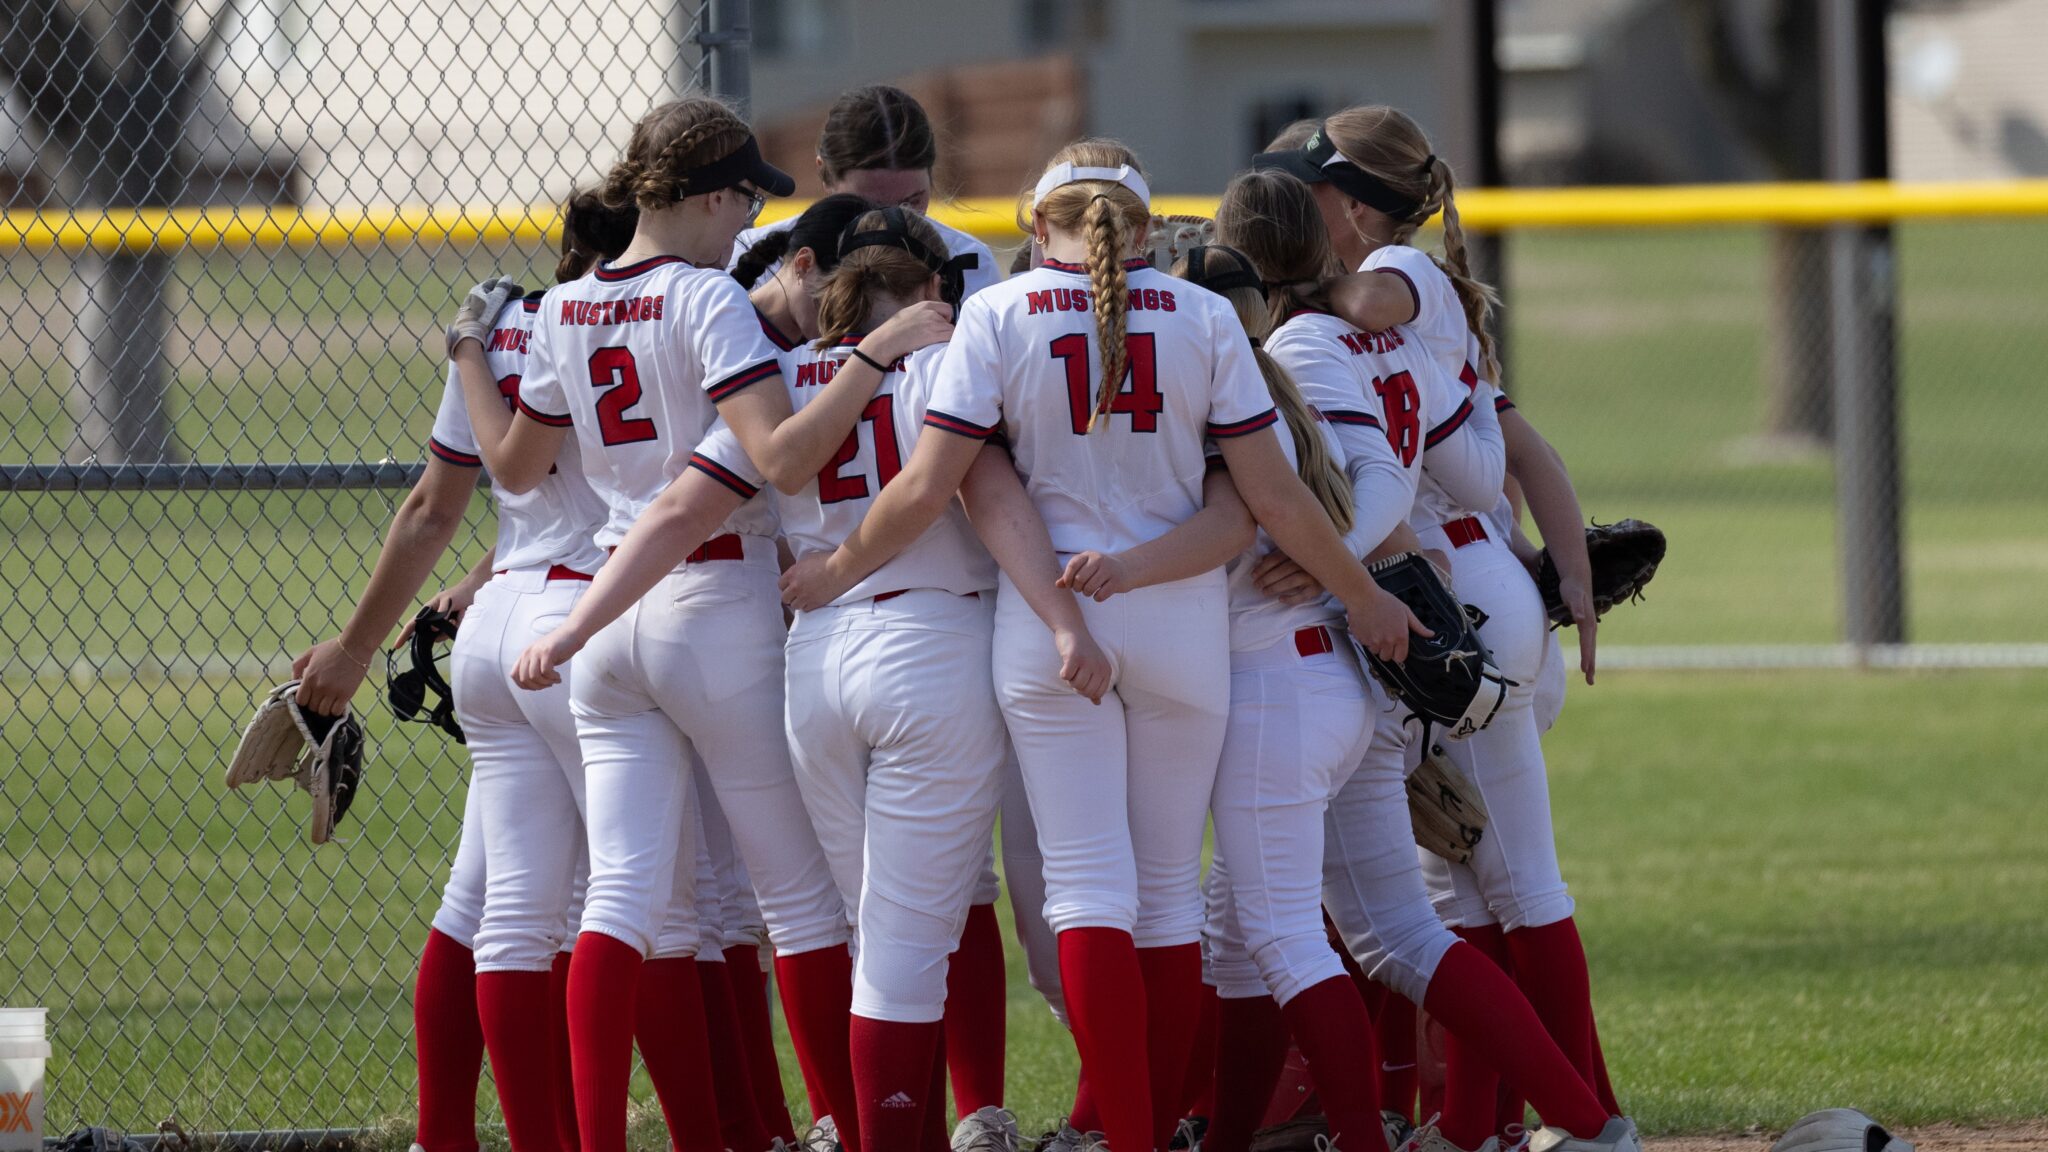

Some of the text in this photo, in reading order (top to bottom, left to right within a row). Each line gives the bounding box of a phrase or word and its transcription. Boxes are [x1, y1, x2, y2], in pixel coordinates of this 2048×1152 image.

[559, 295, 665, 326] MUSTANGS
[1026, 288, 1177, 315] MUSNGS
[588, 345, 658, 447] 2
[1049, 332, 1164, 435] 14
